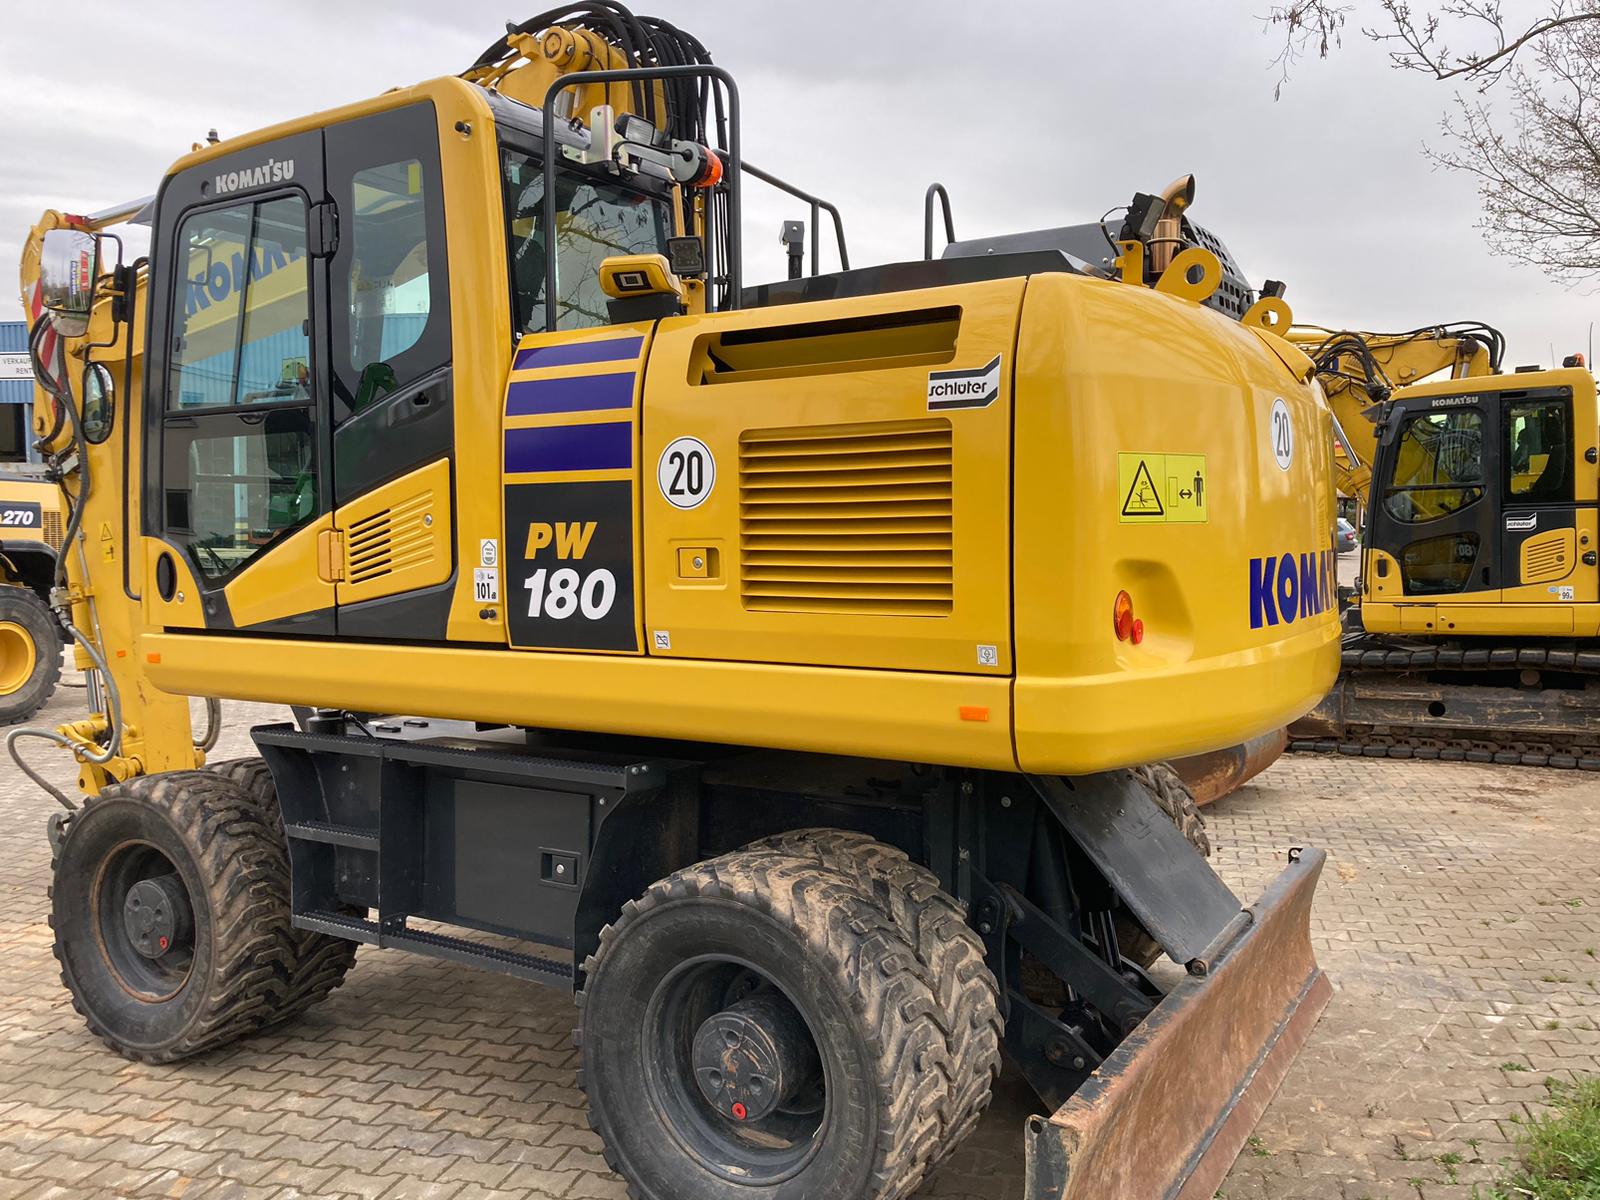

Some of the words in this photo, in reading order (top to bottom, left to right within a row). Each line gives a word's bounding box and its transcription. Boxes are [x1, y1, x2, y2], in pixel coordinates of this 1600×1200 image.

[215, 158, 295, 194] KOMATSU
[186, 245, 300, 316] KOMA
[1431, 395, 1479, 407] KOMATSU
[1274, 410, 1290, 457] 20
[669, 450, 703, 495] 20
[0, 510, 34, 526] 270
[524, 521, 598, 560] PW
[476, 583, 490, 599] 101
[523, 567, 617, 620] 180
[1249, 550, 1337, 630] KOMAT
